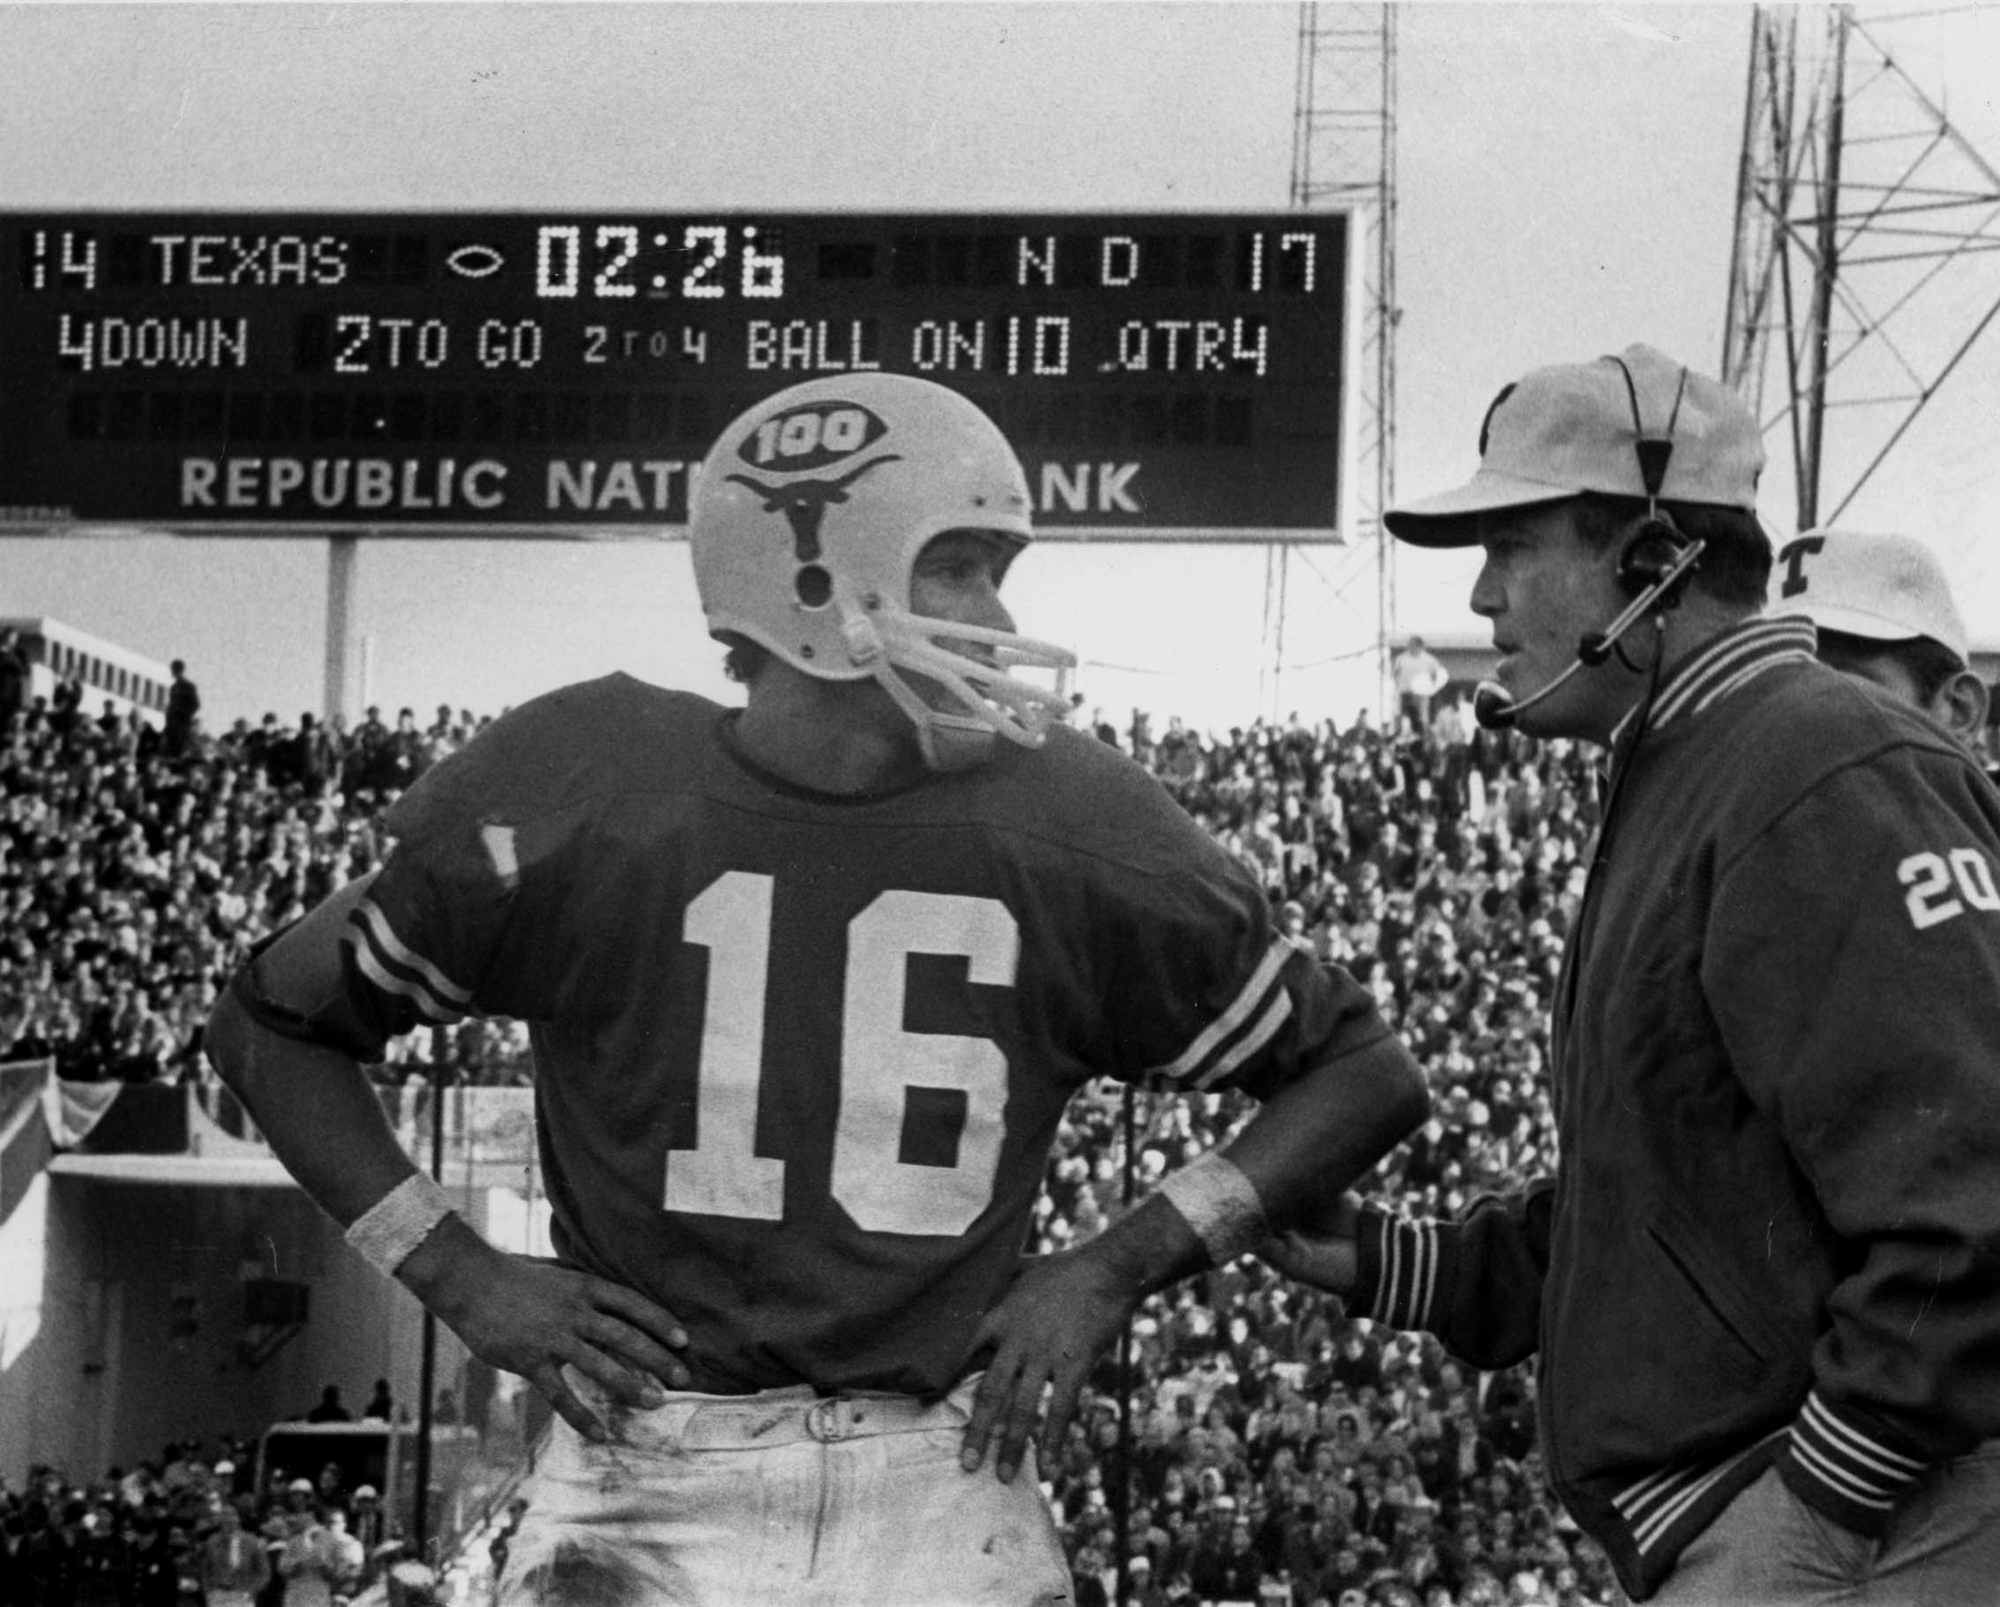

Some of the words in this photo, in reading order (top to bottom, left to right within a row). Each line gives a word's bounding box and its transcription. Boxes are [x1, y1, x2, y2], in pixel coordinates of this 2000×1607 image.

[150, 236, 348, 284] TEXAS
[536, 226, 784, 298] 02:26
[1251, 232, 1316, 292] 17
[478, 319, 542, 368] GO
[747, 320, 880, 370] BALL
[912, 320, 985, 370] ON
[1007, 316, 1070, 376] 10
[755, 408, 868, 464] 100
[182, 459, 507, 508] REPUBLIC
[547, 460, 702, 510] NATI
[1041, 462, 1141, 513] NK
[1778, 535, 1826, 599] T
[1896, 848, 2000, 930] 20
[664, 870, 1021, 1237] 16
